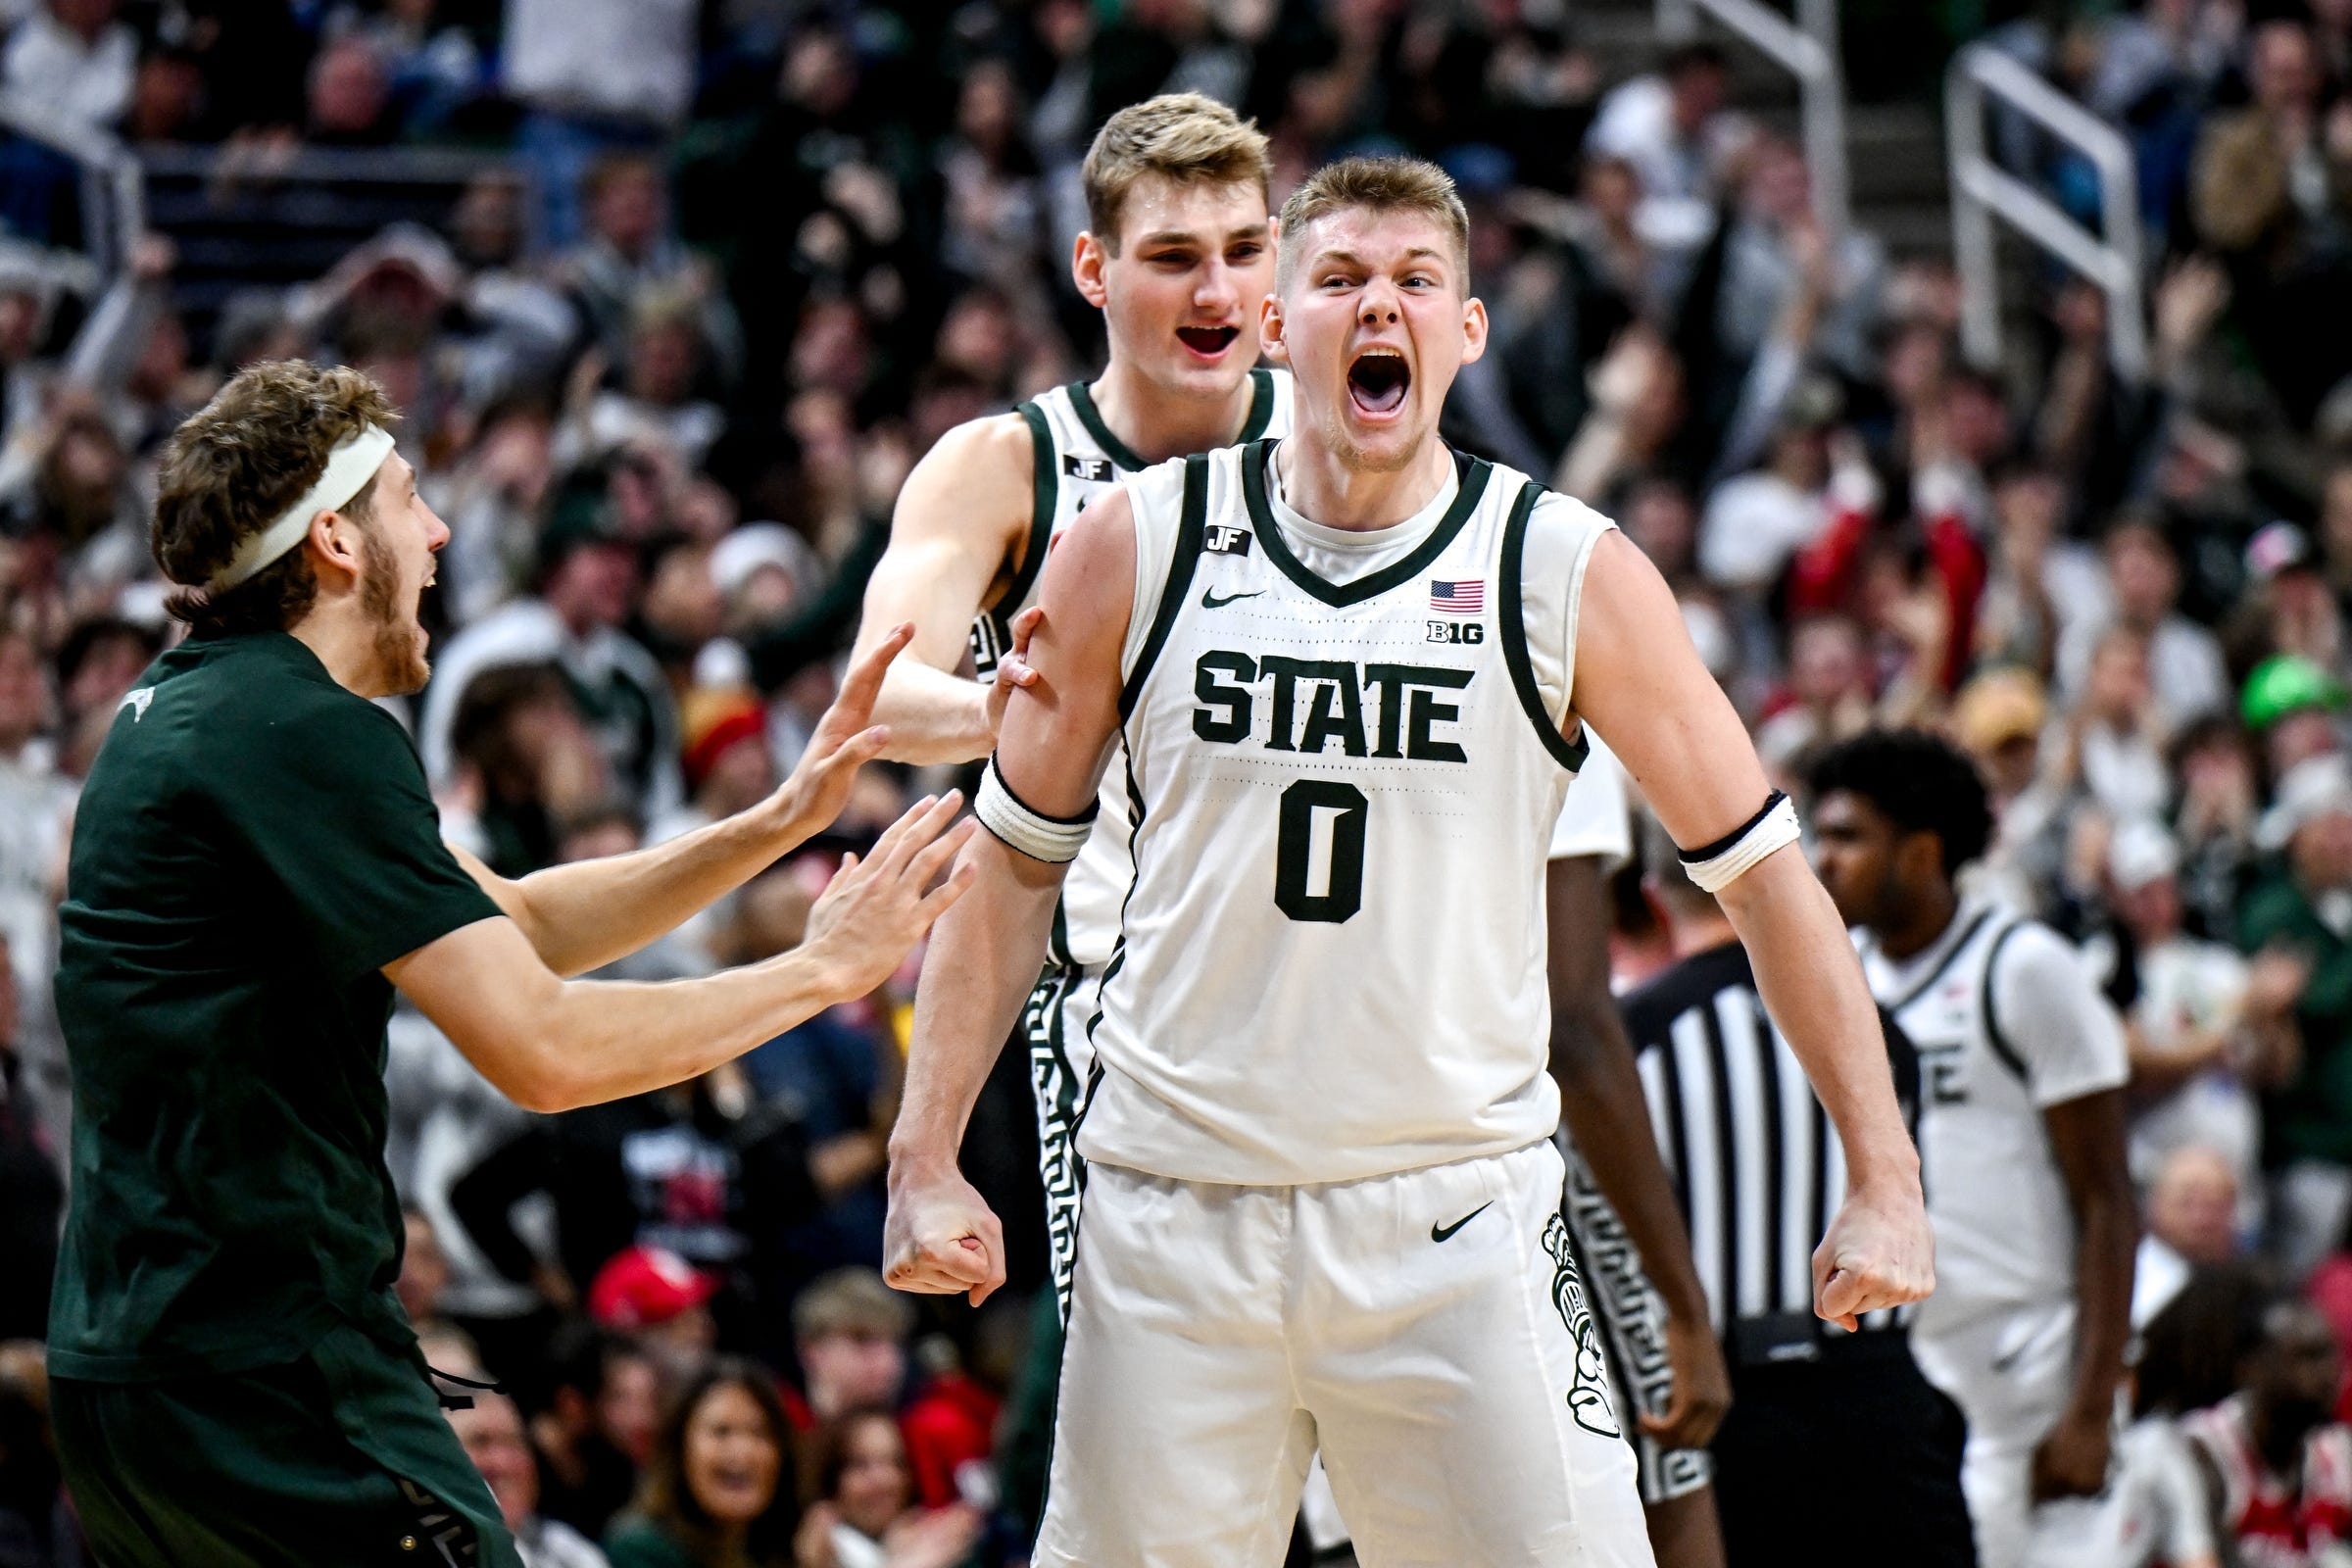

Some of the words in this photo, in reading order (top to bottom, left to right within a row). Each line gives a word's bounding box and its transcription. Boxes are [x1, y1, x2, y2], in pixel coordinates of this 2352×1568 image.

[1072, 461, 1103, 479] JF
[1206, 527, 1243, 552] JF
[1193, 650, 1476, 763] STATE
[1274, 779, 1369, 924] 0
